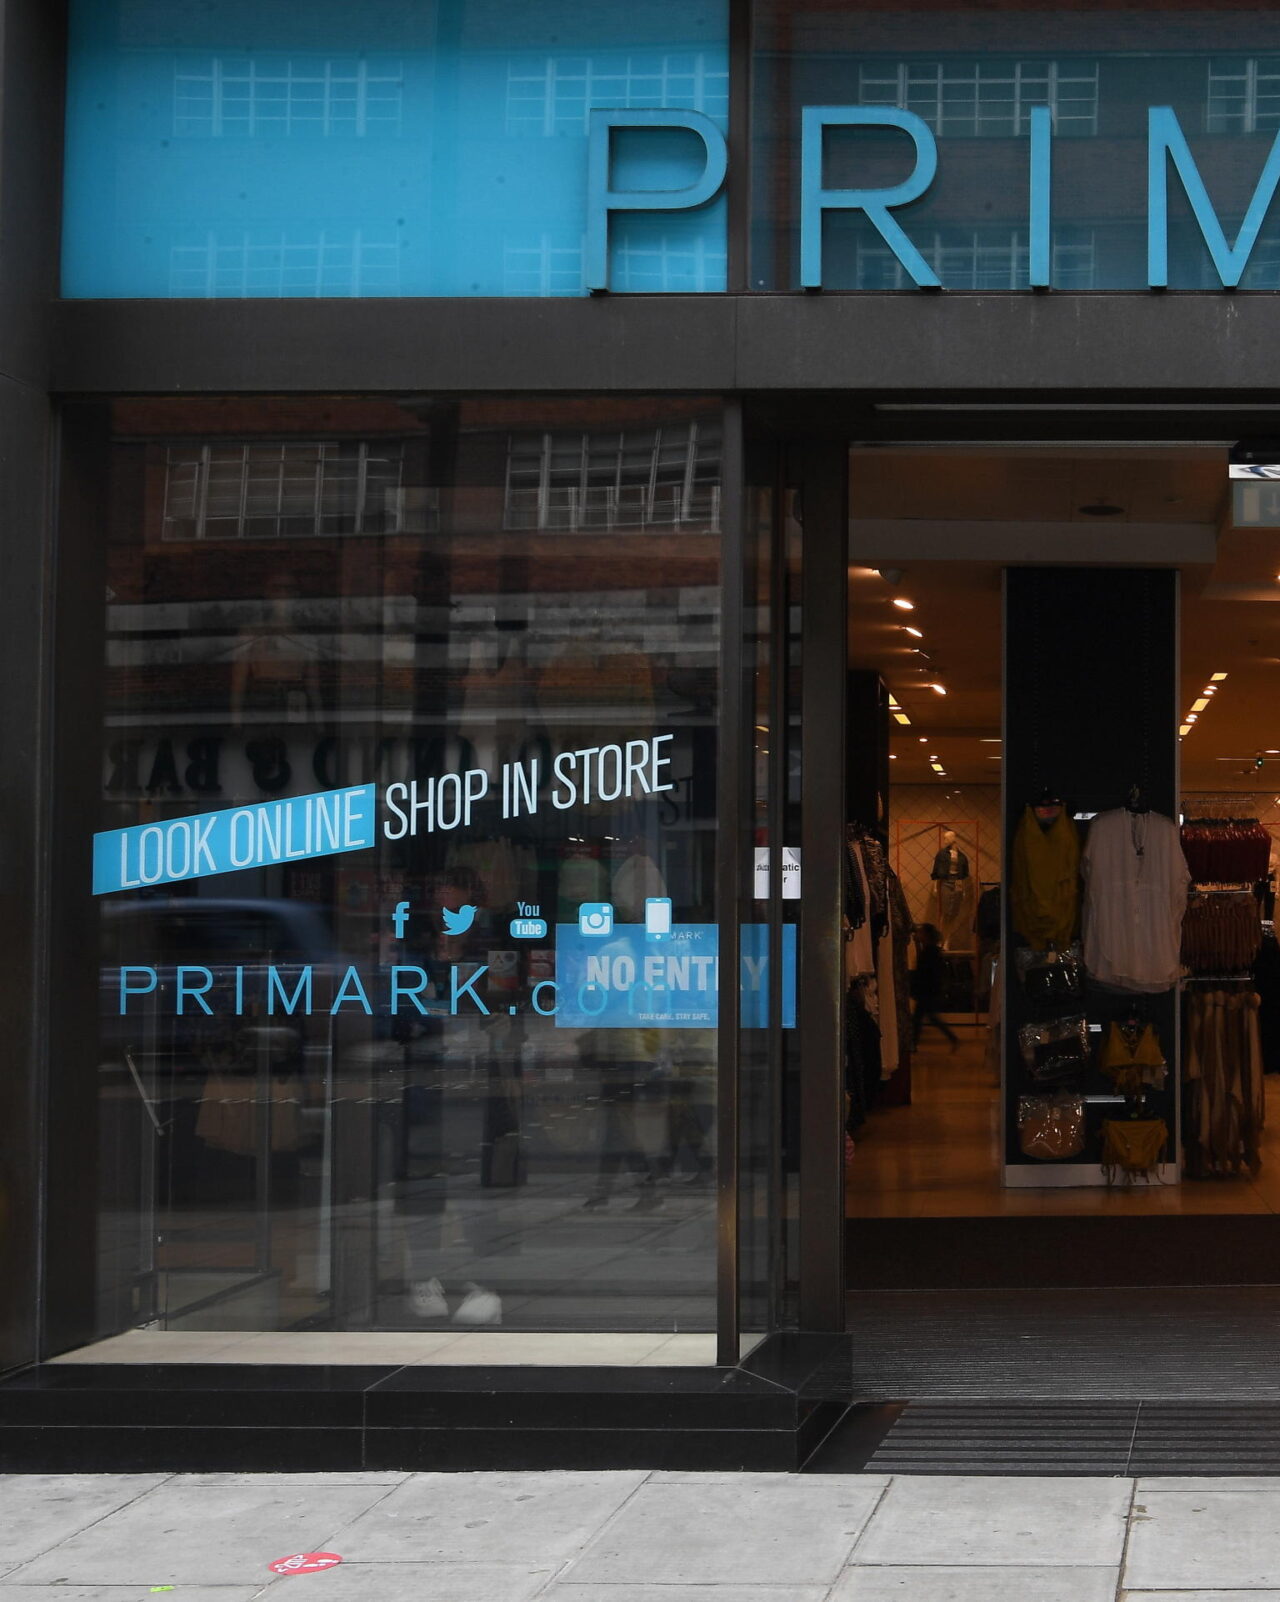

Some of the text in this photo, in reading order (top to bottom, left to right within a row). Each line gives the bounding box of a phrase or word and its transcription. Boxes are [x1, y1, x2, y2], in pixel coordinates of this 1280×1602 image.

[383, 768, 488, 840] SHOP
[501, 758, 538, 820] IN
[552, 734, 674, 810] STORE
[119, 789, 366, 888] LOOK ONLINE
[517, 902, 540, 916] You
[515, 921, 541, 935] Tube
[670, 932, 701, 940] MARK
[118, 964, 672, 1018] PRIMARK.com
[586, 956, 769, 991] NO ENTY
